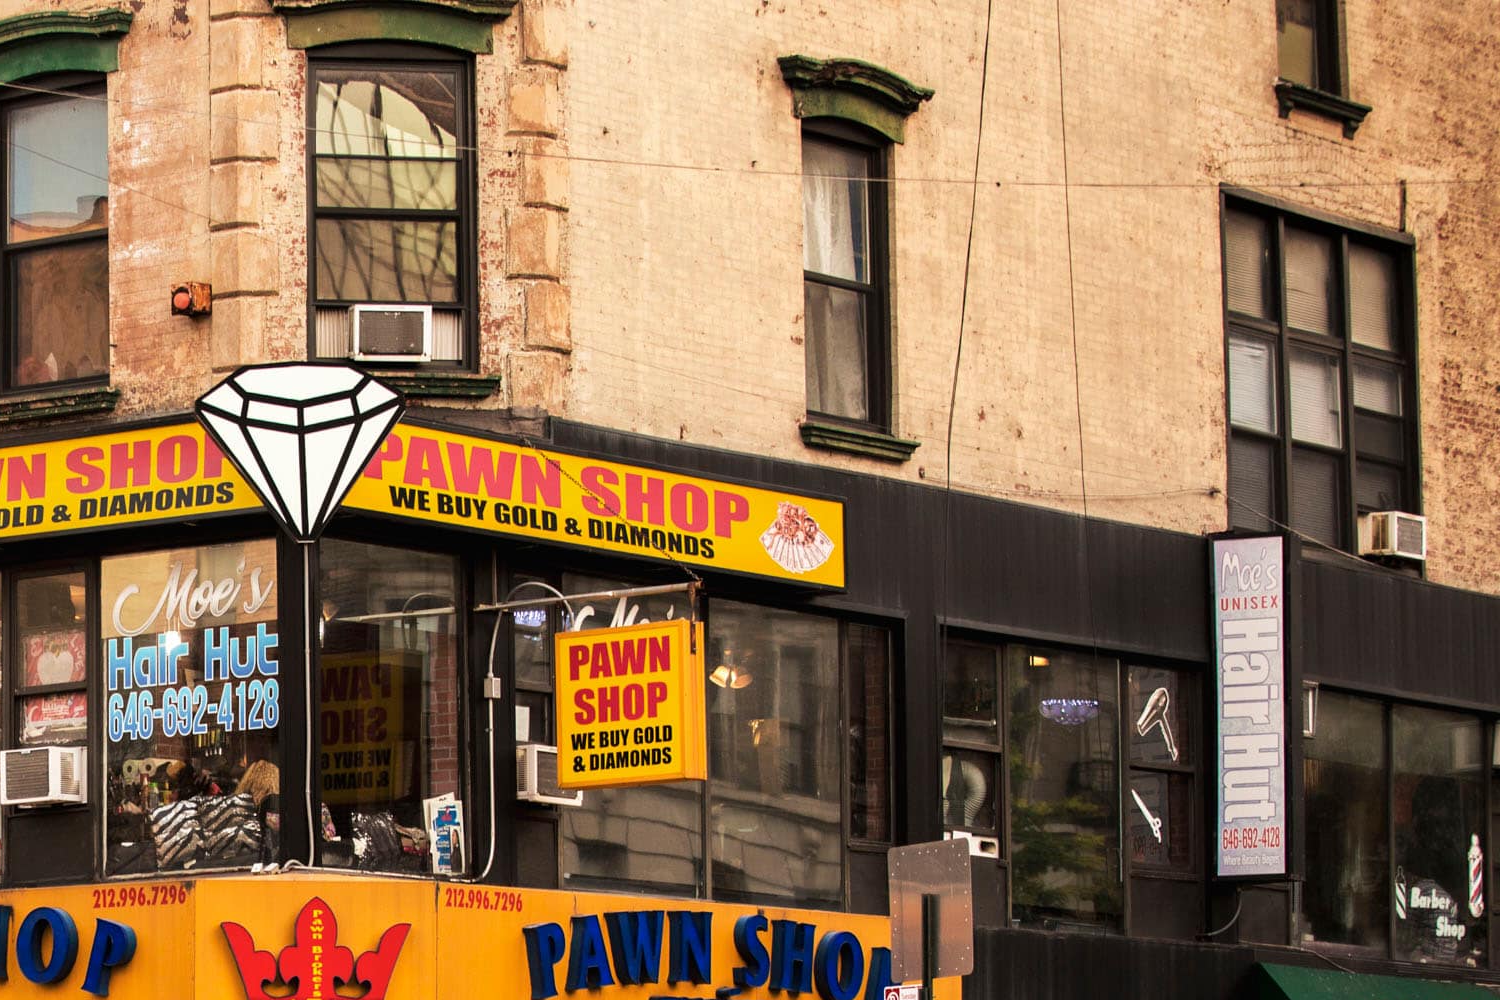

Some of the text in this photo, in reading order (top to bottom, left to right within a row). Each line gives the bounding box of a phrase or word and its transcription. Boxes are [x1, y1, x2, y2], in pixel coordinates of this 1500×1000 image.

[51, 505, 72, 523] &
[79, 482, 234, 520] DIAMONDS
[363, 433, 750, 539] PAWN SHOP
[389, 485, 715, 559] WE BUY GOLD & DIAMONDS
[1221, 548, 1277, 592] Moe's
[112, 555, 275, 636] Moe's
[1221, 596, 1278, 611] UNISEX
[108, 631, 189, 691] Hair
[204, 623, 279, 681] Hut
[569, 636, 670, 681] PAWN
[1222, 617, 1279, 725] Hair
[108, 678, 280, 742] 646-692-4128
[574, 682, 668, 725] SHOP
[571, 725, 673, 751] WE BUY GOLD
[573, 747, 672, 772] & DIAMONDS
[1223, 733, 1280, 823] Hut
[1223, 827, 1280, 849] 646-692-4128
[93, 888, 186, 909] 212.996.7296
[445, 888, 523, 912] 212.996.7296
[1436, 916, 1466, 940] Shop
[522, 910, 713, 1000] PAWN
